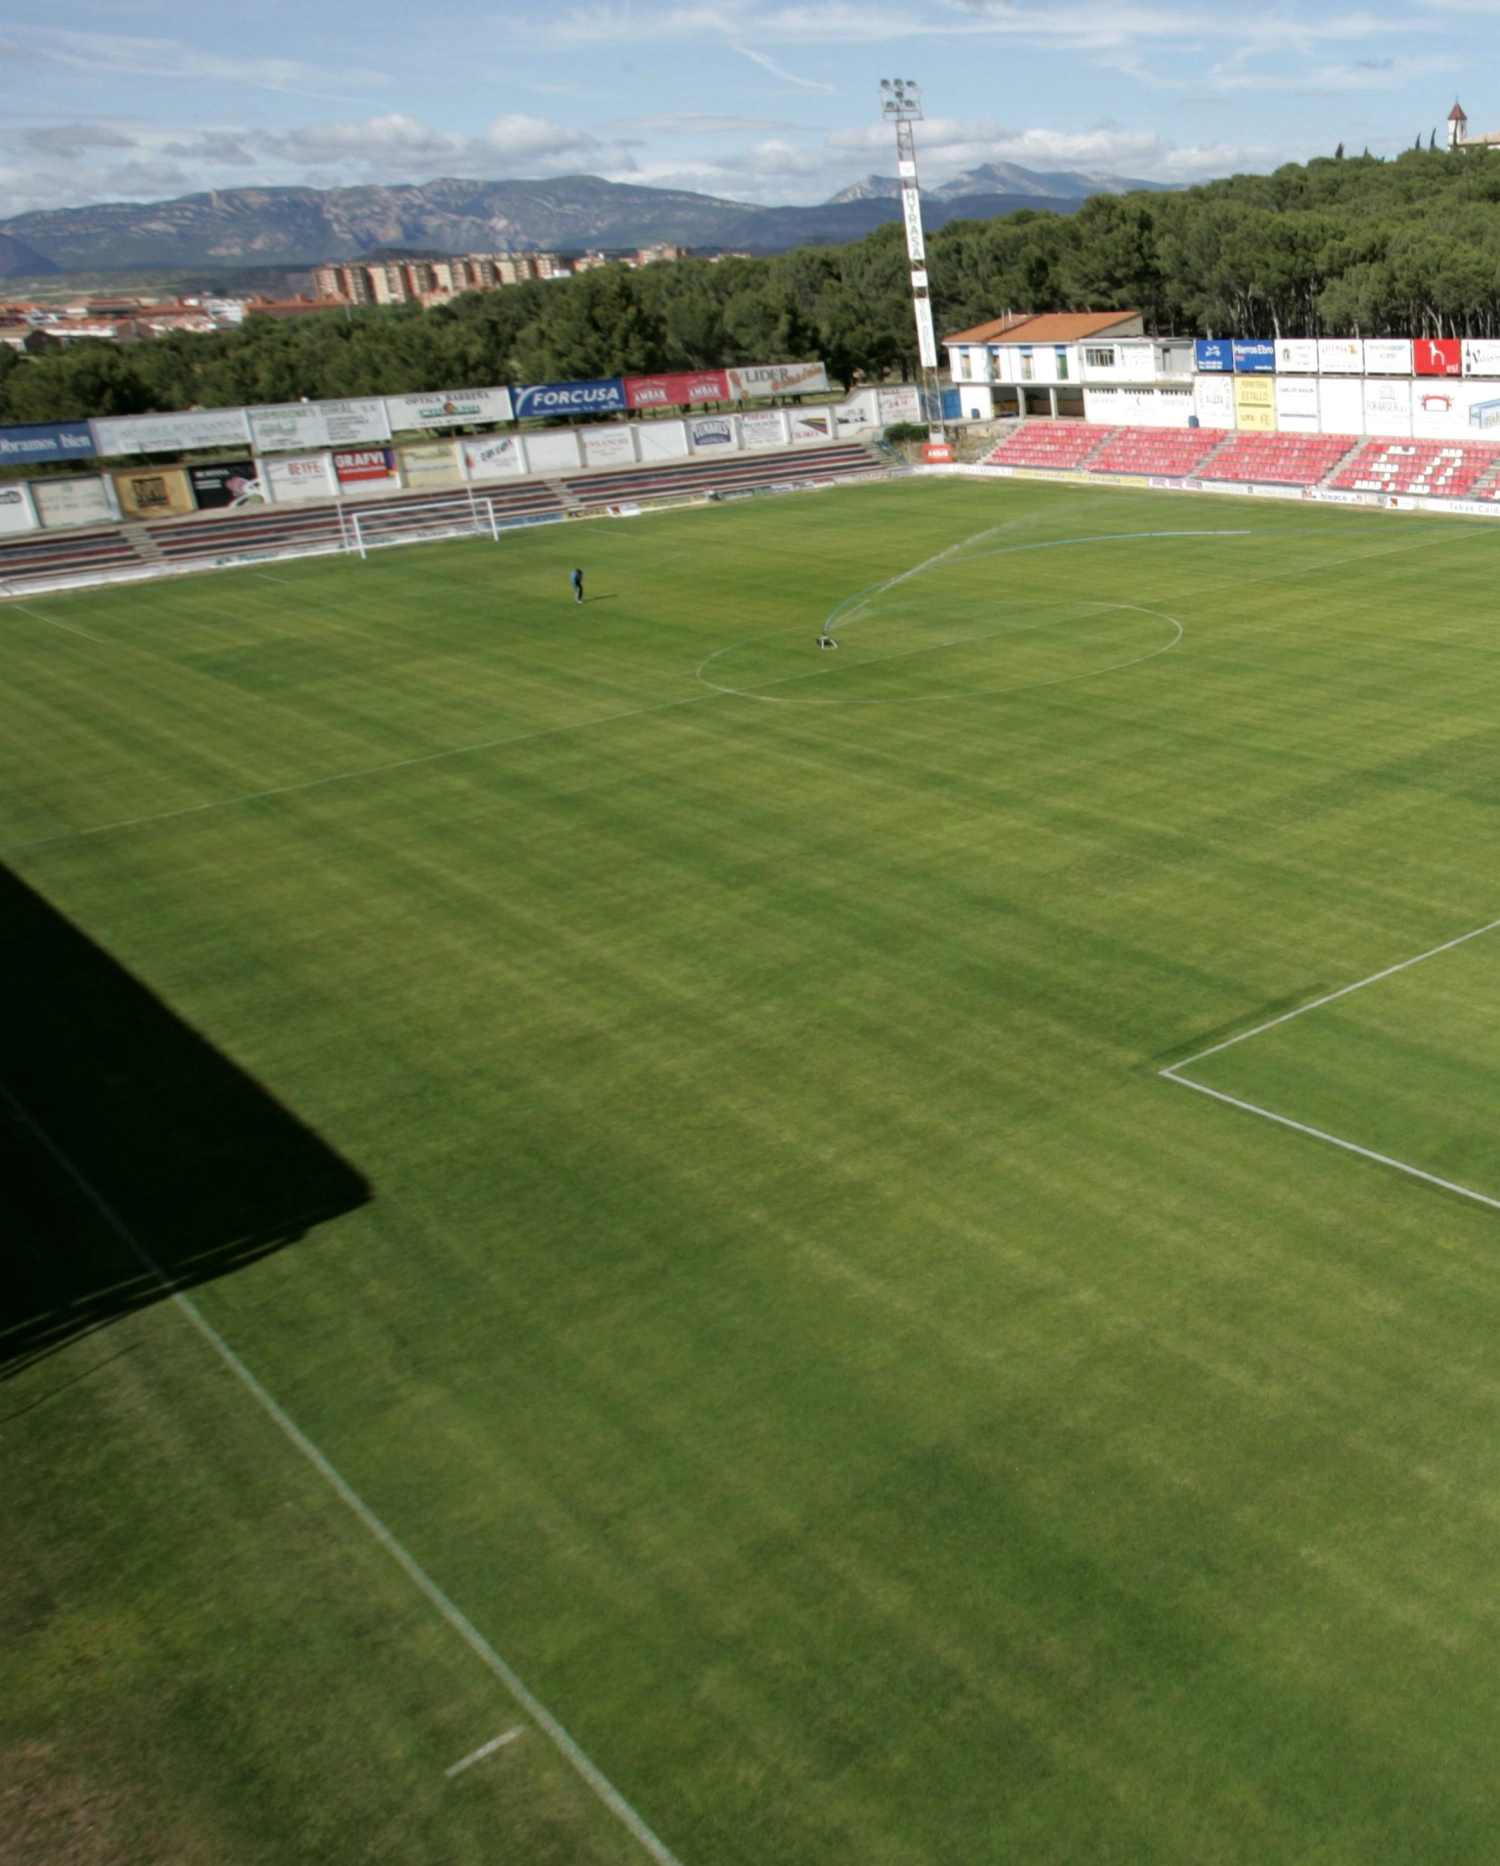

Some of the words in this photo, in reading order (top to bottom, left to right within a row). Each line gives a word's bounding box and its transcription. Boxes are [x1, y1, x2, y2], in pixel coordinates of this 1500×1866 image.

[744, 367, 789, 383] LIDER
[532, 387, 620, 407] FORCUSA
[634, 389, 668, 404] AMBAR
[688, 384, 722, 399] AMBAR
